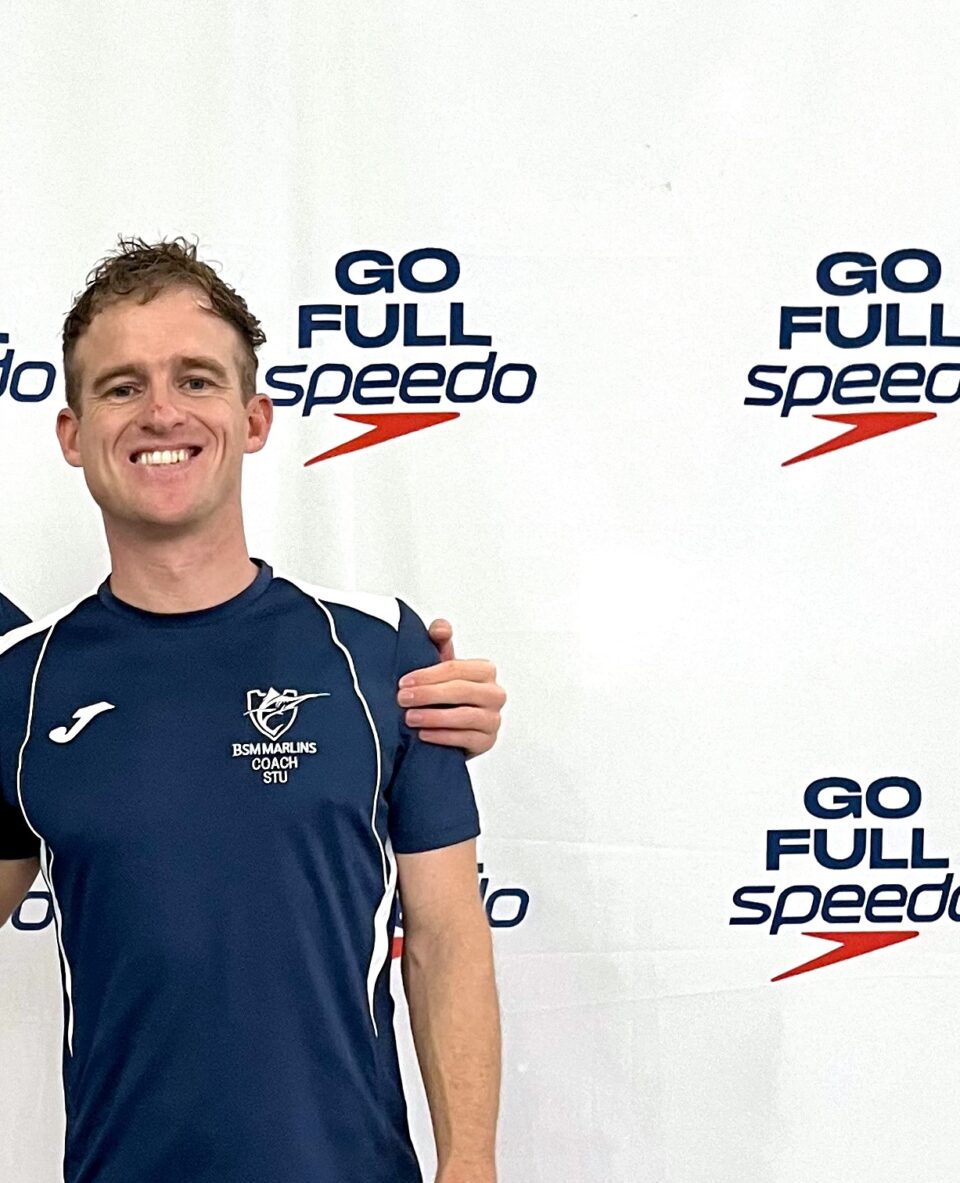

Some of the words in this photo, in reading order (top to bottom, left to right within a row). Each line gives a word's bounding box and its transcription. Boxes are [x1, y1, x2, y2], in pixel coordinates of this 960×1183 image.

[334, 247, 461, 296] GO
[816, 248, 942, 297] GO
[298, 302, 493, 349] FULL
[778, 302, 960, 350] FULL
[265, 351, 538, 418] speedo
[743, 361, 960, 418] speed
[232, 743, 261, 757] BSM
[262, 741, 318, 755] MARLINS
[251, 756, 299, 771] COACH
[263, 770, 288, 784] STU
[803, 775, 922, 820] GO
[765, 827, 950, 871] FULL
[728, 872, 960, 936] speed
